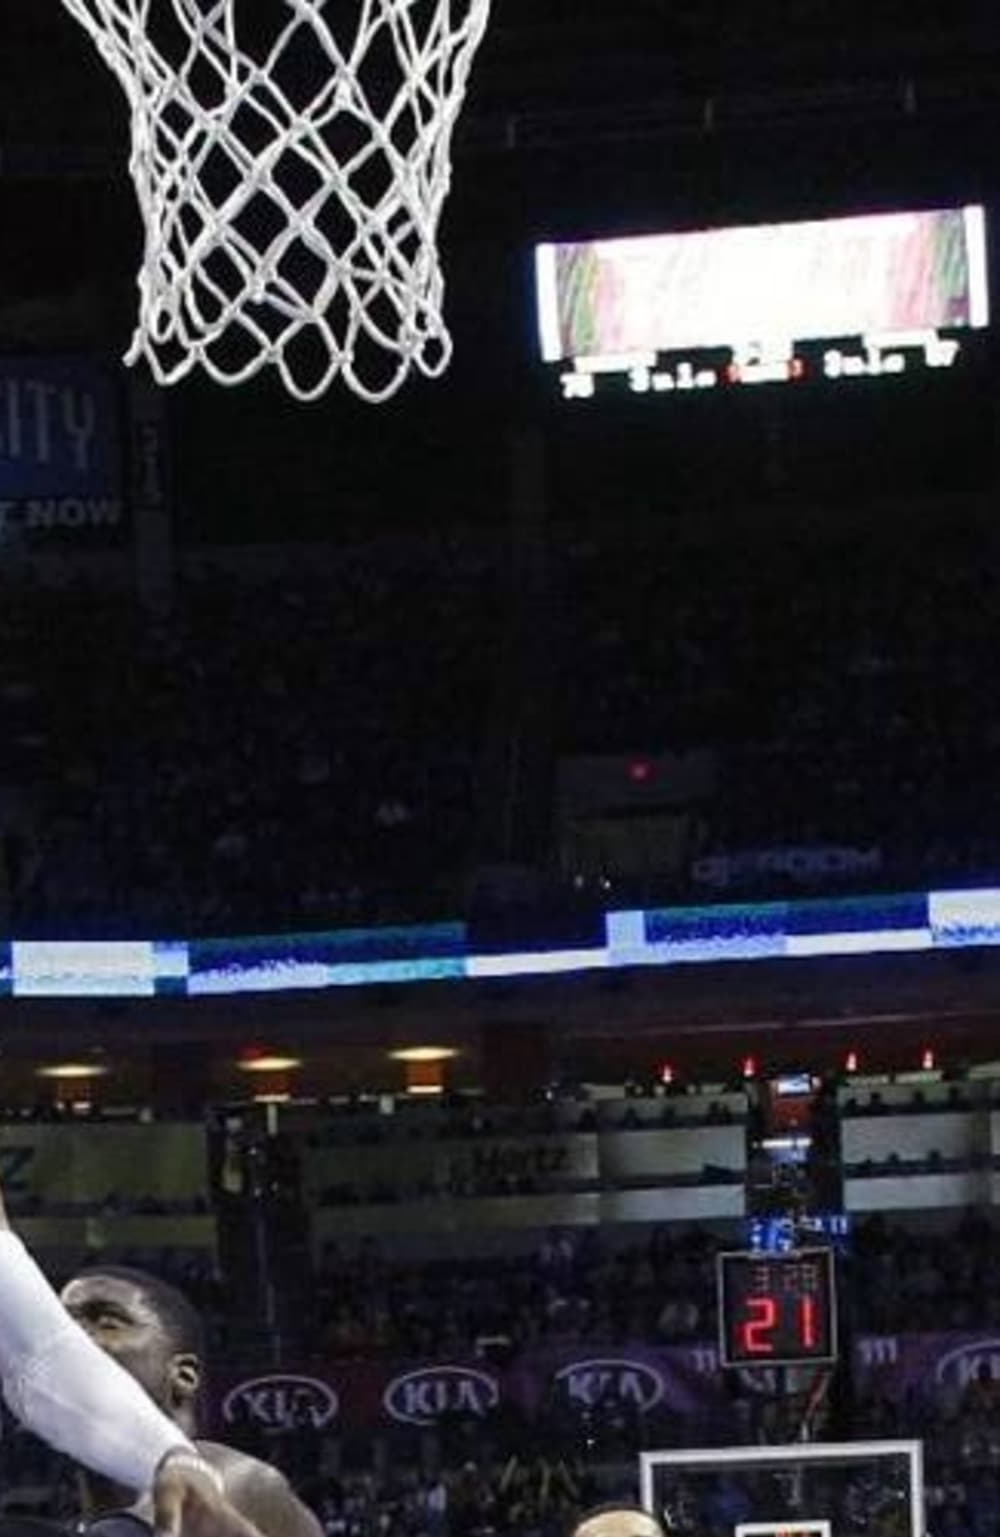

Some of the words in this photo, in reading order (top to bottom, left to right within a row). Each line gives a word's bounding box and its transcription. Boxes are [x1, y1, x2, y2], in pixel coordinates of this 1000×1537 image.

[28, 499, 120, 528] NOW
[739, 1297, 820, 1353] 21
[404, 1383, 485, 1415] KIA
